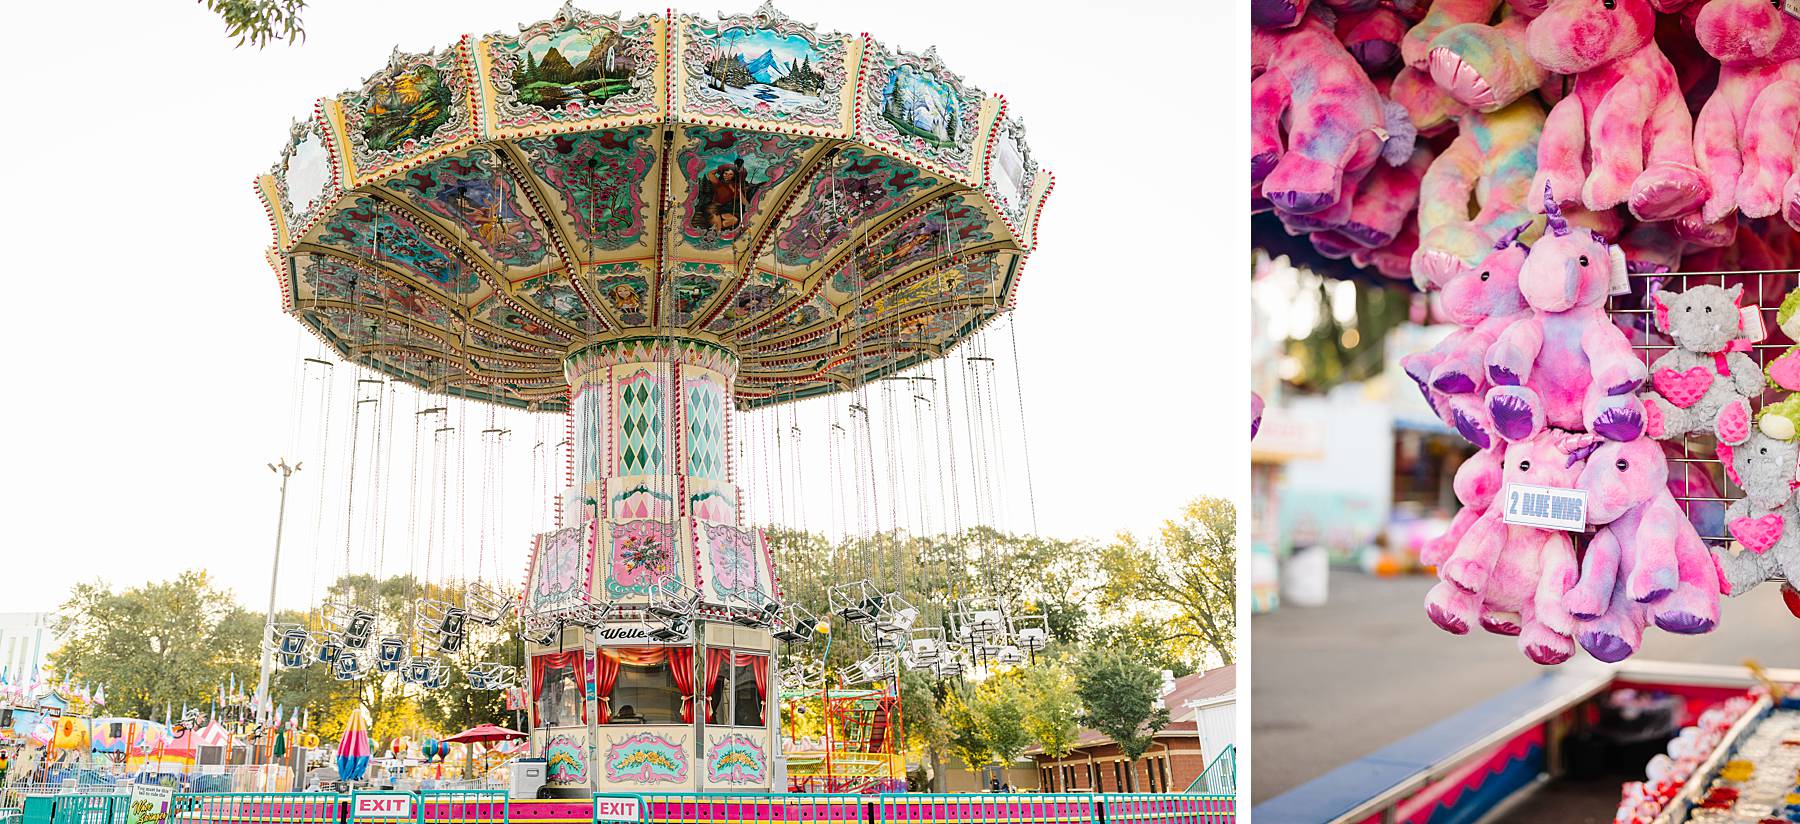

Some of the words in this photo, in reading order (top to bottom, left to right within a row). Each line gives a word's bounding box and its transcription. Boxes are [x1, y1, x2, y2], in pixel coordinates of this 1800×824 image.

[1509, 491, 1519, 514] 2
[1522, 492, 1551, 518] BLUE
[1551, 495, 1583, 522] WINS
[360, 799, 405, 811] EXIT
[600, 802, 635, 816] EXIT
